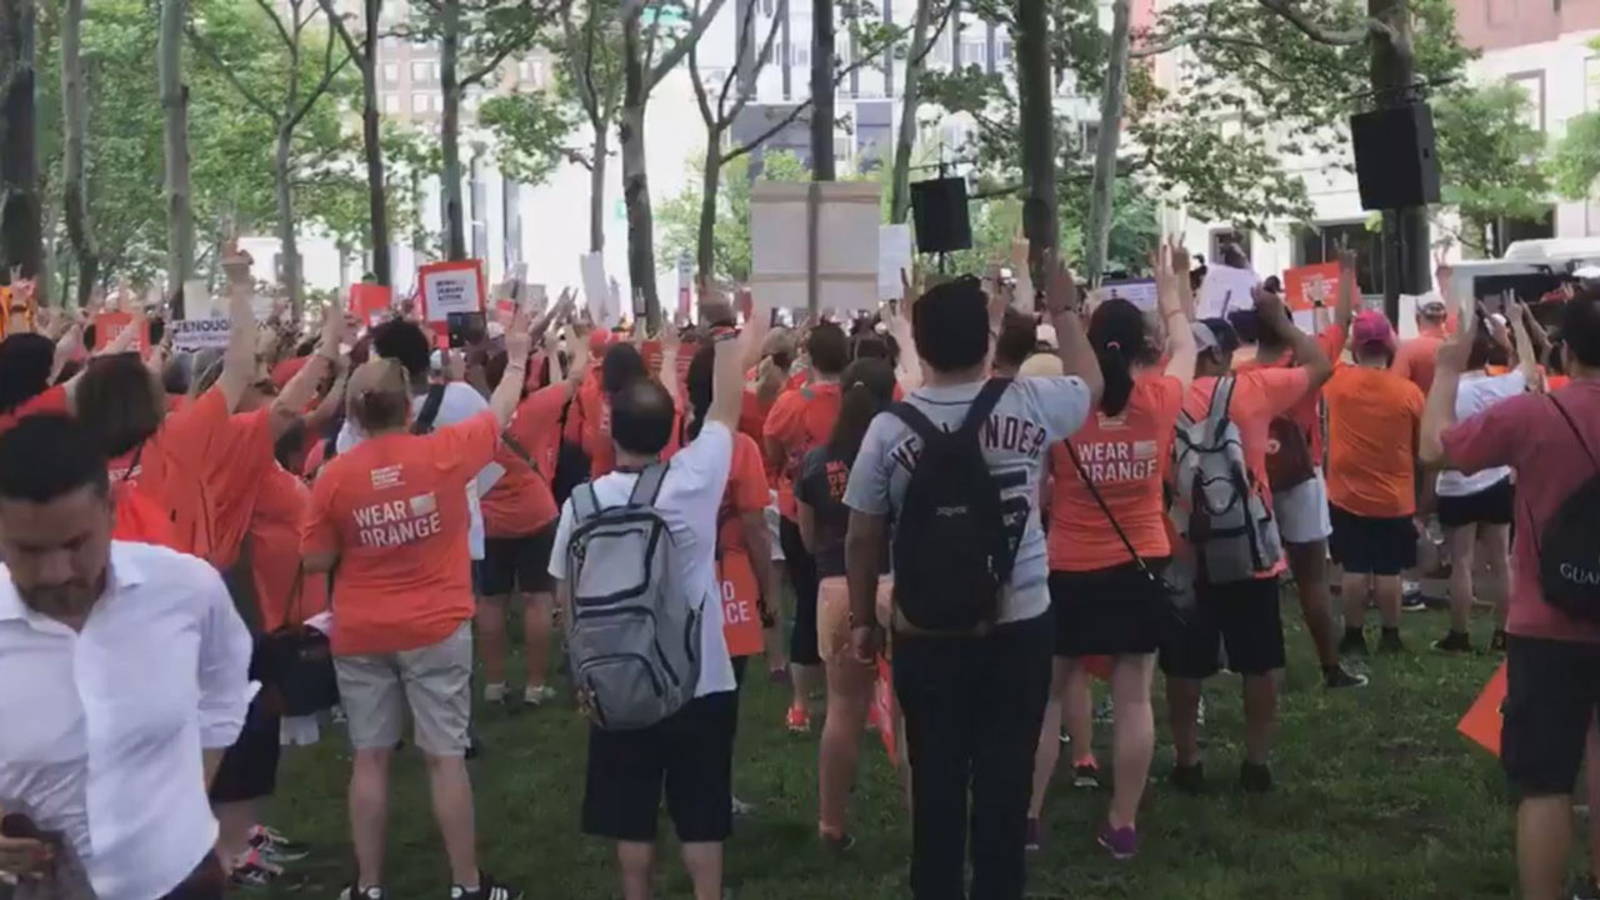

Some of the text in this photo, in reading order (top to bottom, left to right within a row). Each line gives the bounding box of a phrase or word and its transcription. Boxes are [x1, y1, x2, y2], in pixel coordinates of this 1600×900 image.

[889, 414, 1047, 472] VENDER
[1078, 442, 1129, 461] WEAR
[352, 500, 407, 528] WEAR
[360, 512, 442, 548] ORANGE
